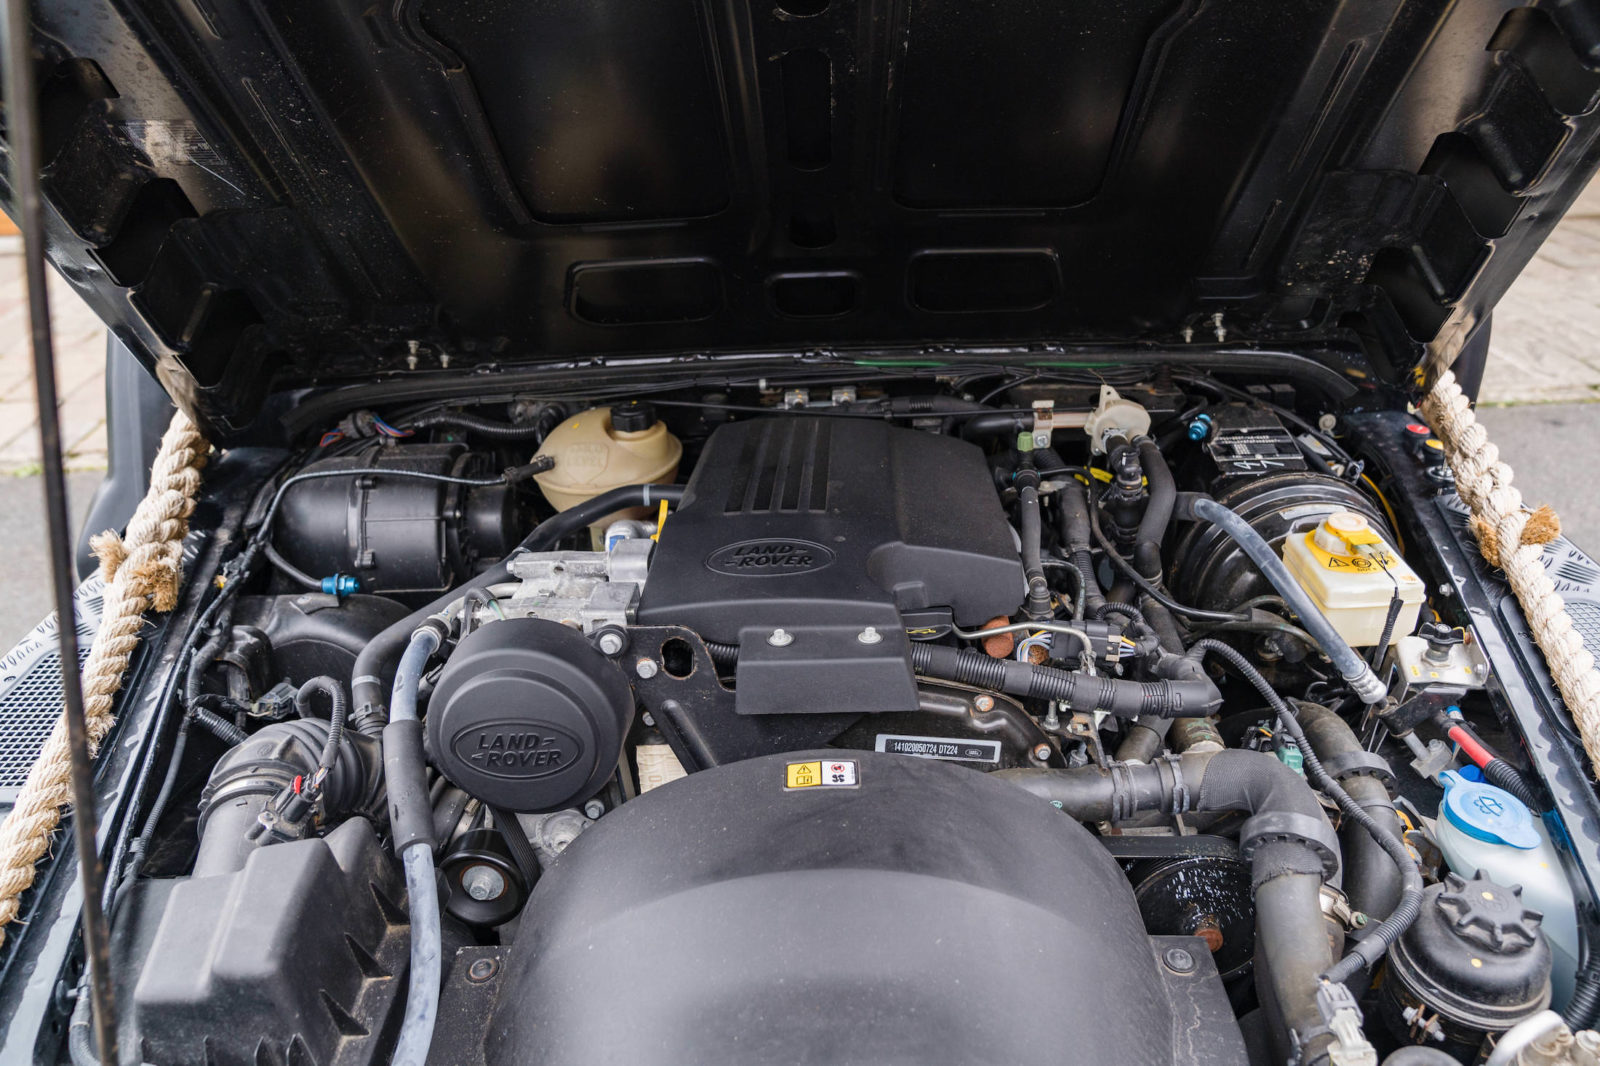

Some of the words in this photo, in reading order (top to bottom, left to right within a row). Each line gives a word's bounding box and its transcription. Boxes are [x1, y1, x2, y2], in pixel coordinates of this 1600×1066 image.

[734, 545, 794, 557] LAND
[738, 555, 812, 568] ROVER
[478, 732, 540, 750] LAND
[486, 748, 562, 767] ROVER
